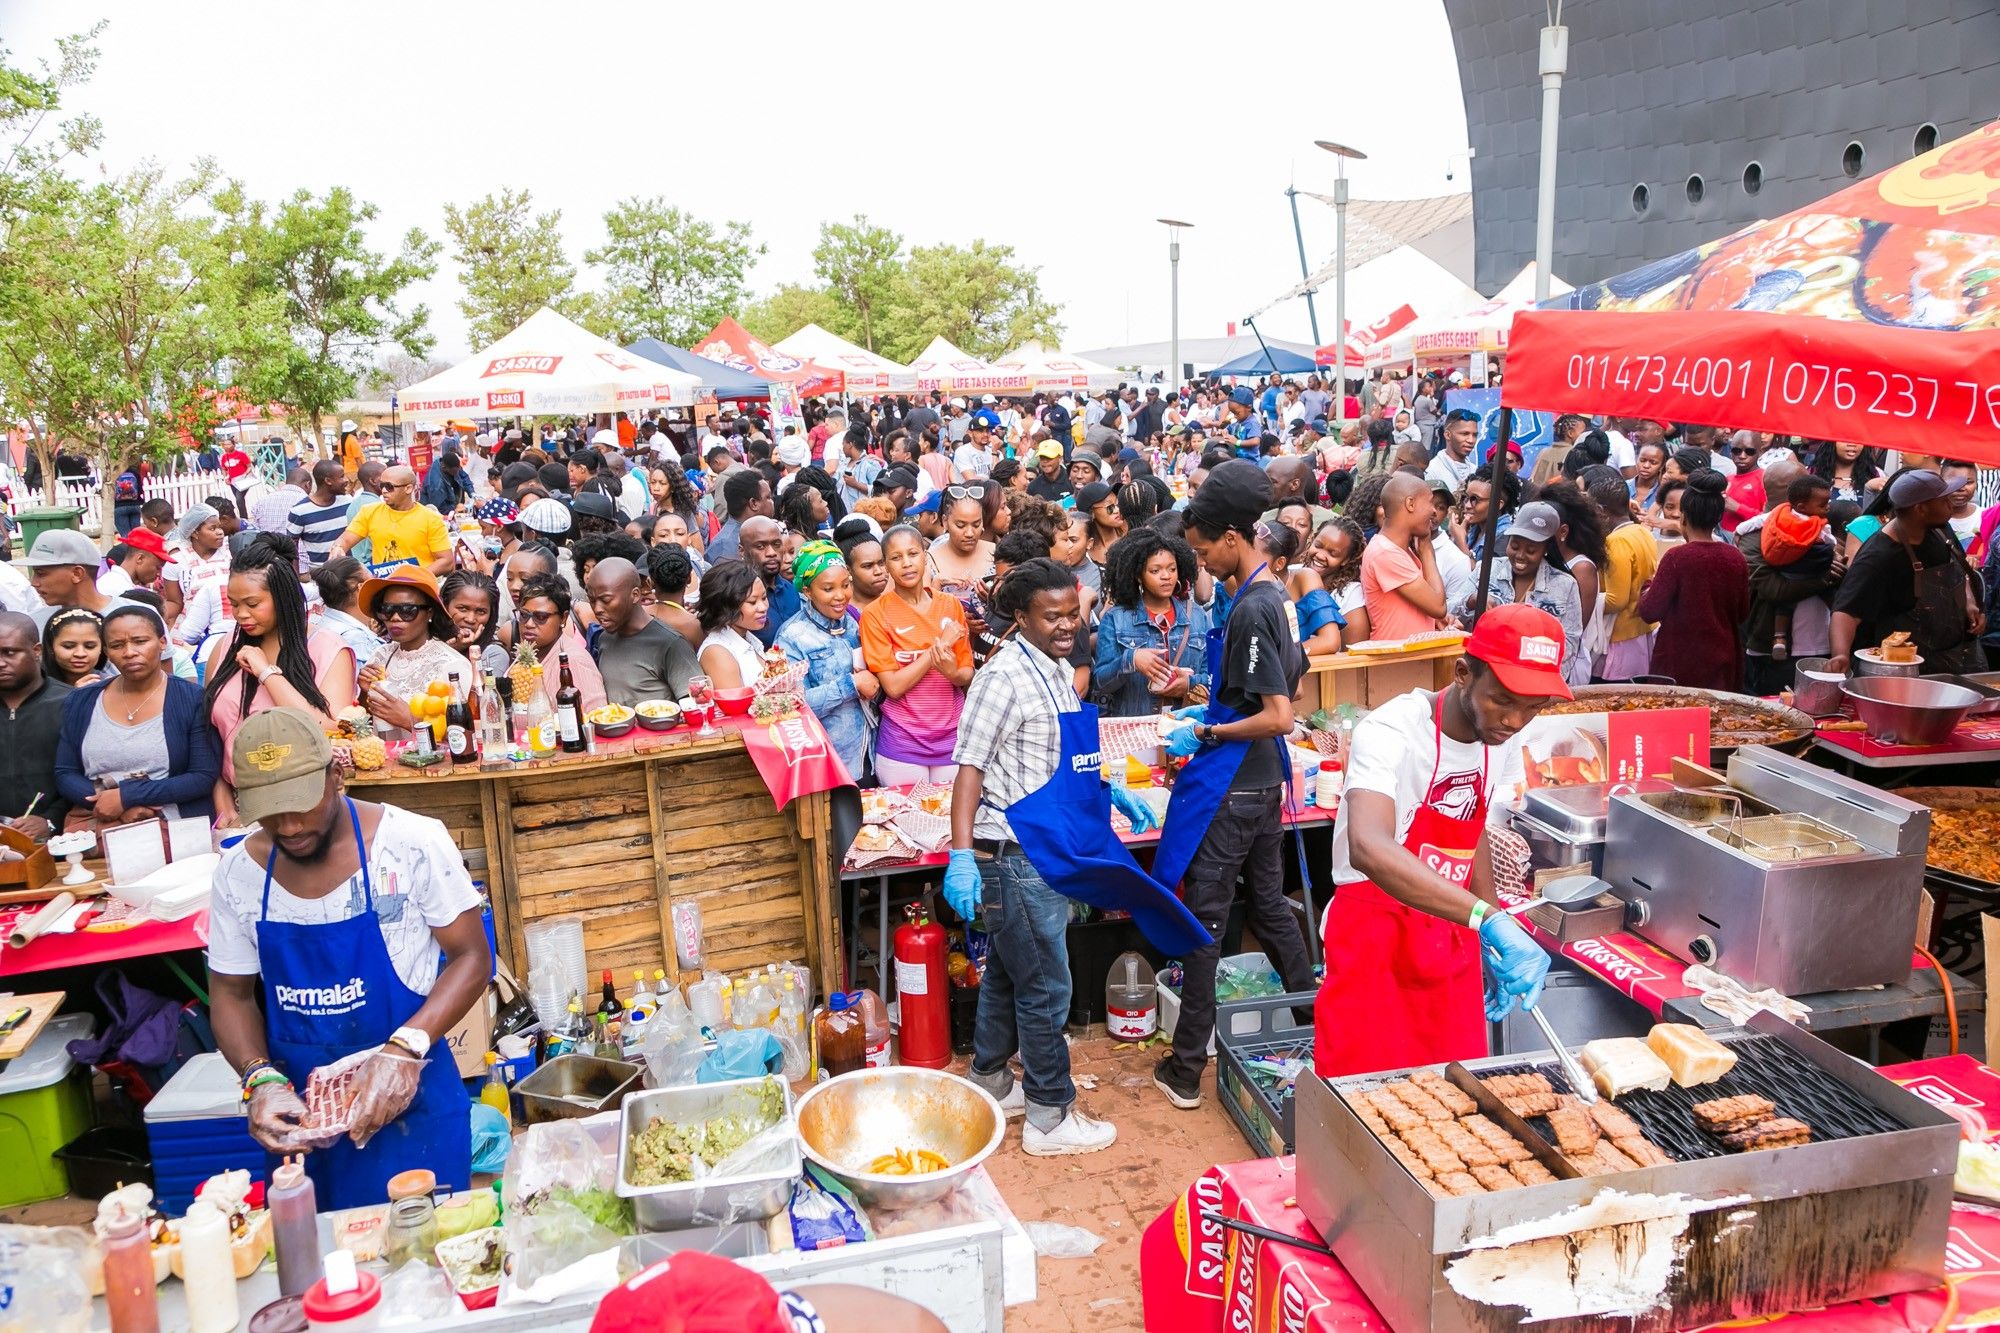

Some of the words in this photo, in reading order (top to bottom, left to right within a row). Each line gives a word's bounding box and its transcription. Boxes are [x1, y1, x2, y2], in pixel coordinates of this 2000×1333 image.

[1416, 333, 1431, 349] LIFE
[1432, 332, 1454, 348] TASTES
[1455, 331, 1478, 348] GREAT
[491, 357, 554, 374] SASKO
[917, 379, 941, 390] REAT
[952, 378, 967, 389] LIFE
[970, 377, 1001, 388] TASTES
[1003, 376, 1028, 387] GREAT
[1567, 354, 1610, 389] 011
[1615, 356, 1667, 393] 473
[1672, 357, 1752, 399] 4001
[1783, 362, 1856, 410] 076
[1867, 371, 1938, 420] 237
[404, 401, 421, 411] LIFE
[422, 399, 452, 410] TASTES
[454, 397, 480, 408] GREAT
[490, 392, 521, 406] SASKO
[1526, 642, 1557, 660] SASKO
[1635, 734, 1643, 756] 2017
[1635, 757, 1644, 779] Sept
[1427, 854, 1471, 882] SAS
[1573, 939, 1644, 980] SASKO
[275, 977, 366, 1006] parmalat
[1195, 1176, 1224, 1284] SASKO
